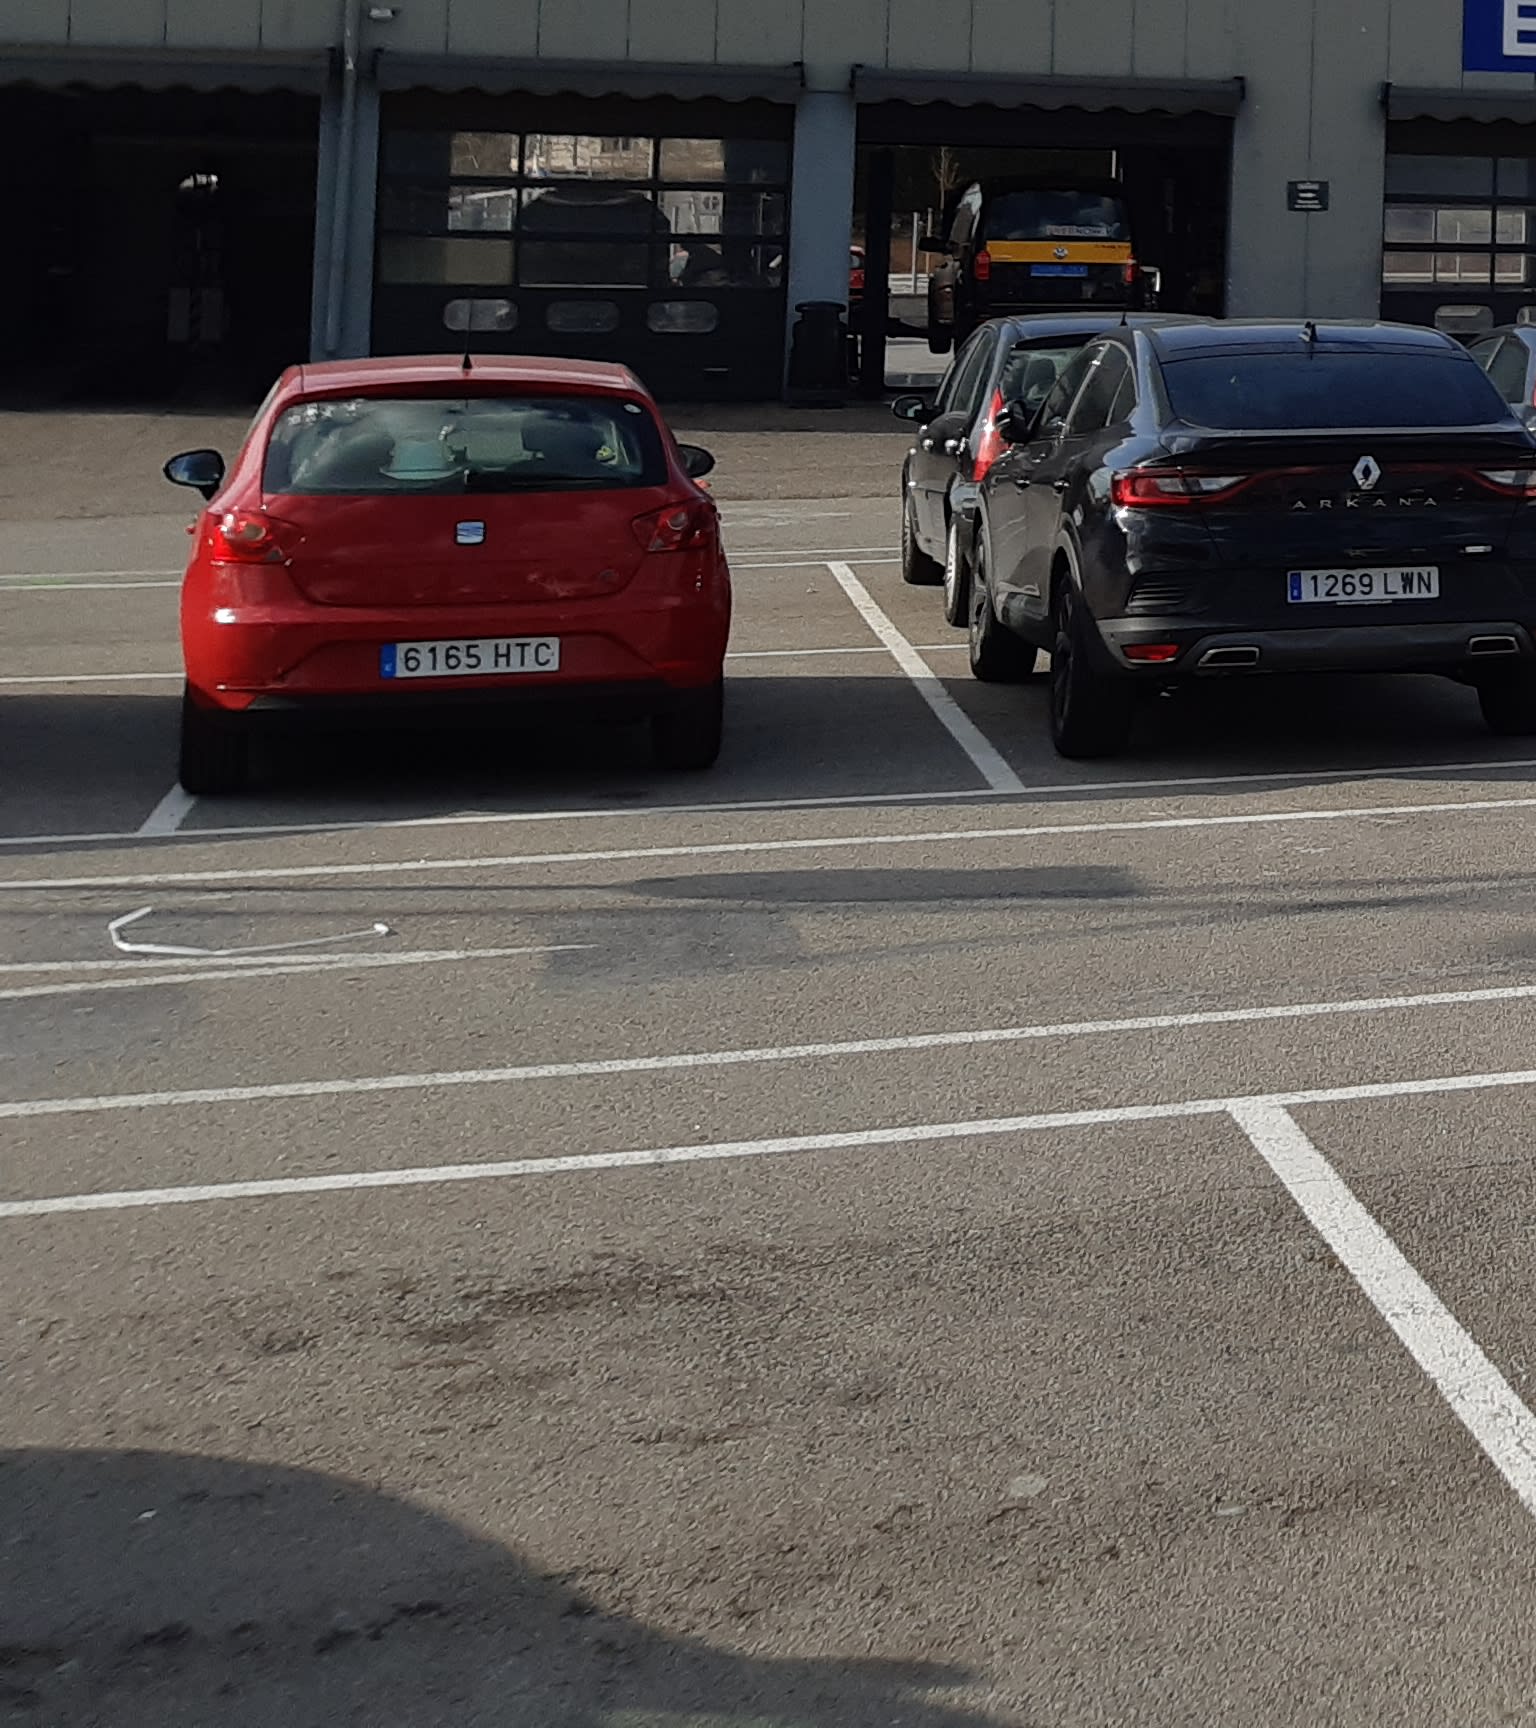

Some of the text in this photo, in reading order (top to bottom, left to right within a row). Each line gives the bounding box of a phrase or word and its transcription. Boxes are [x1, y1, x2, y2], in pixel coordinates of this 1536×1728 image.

[1292, 497, 1438, 510] ARKANA
[1309, 571, 1433, 598] 1269 LWN
[404, 642, 552, 672] 6165 HTC
